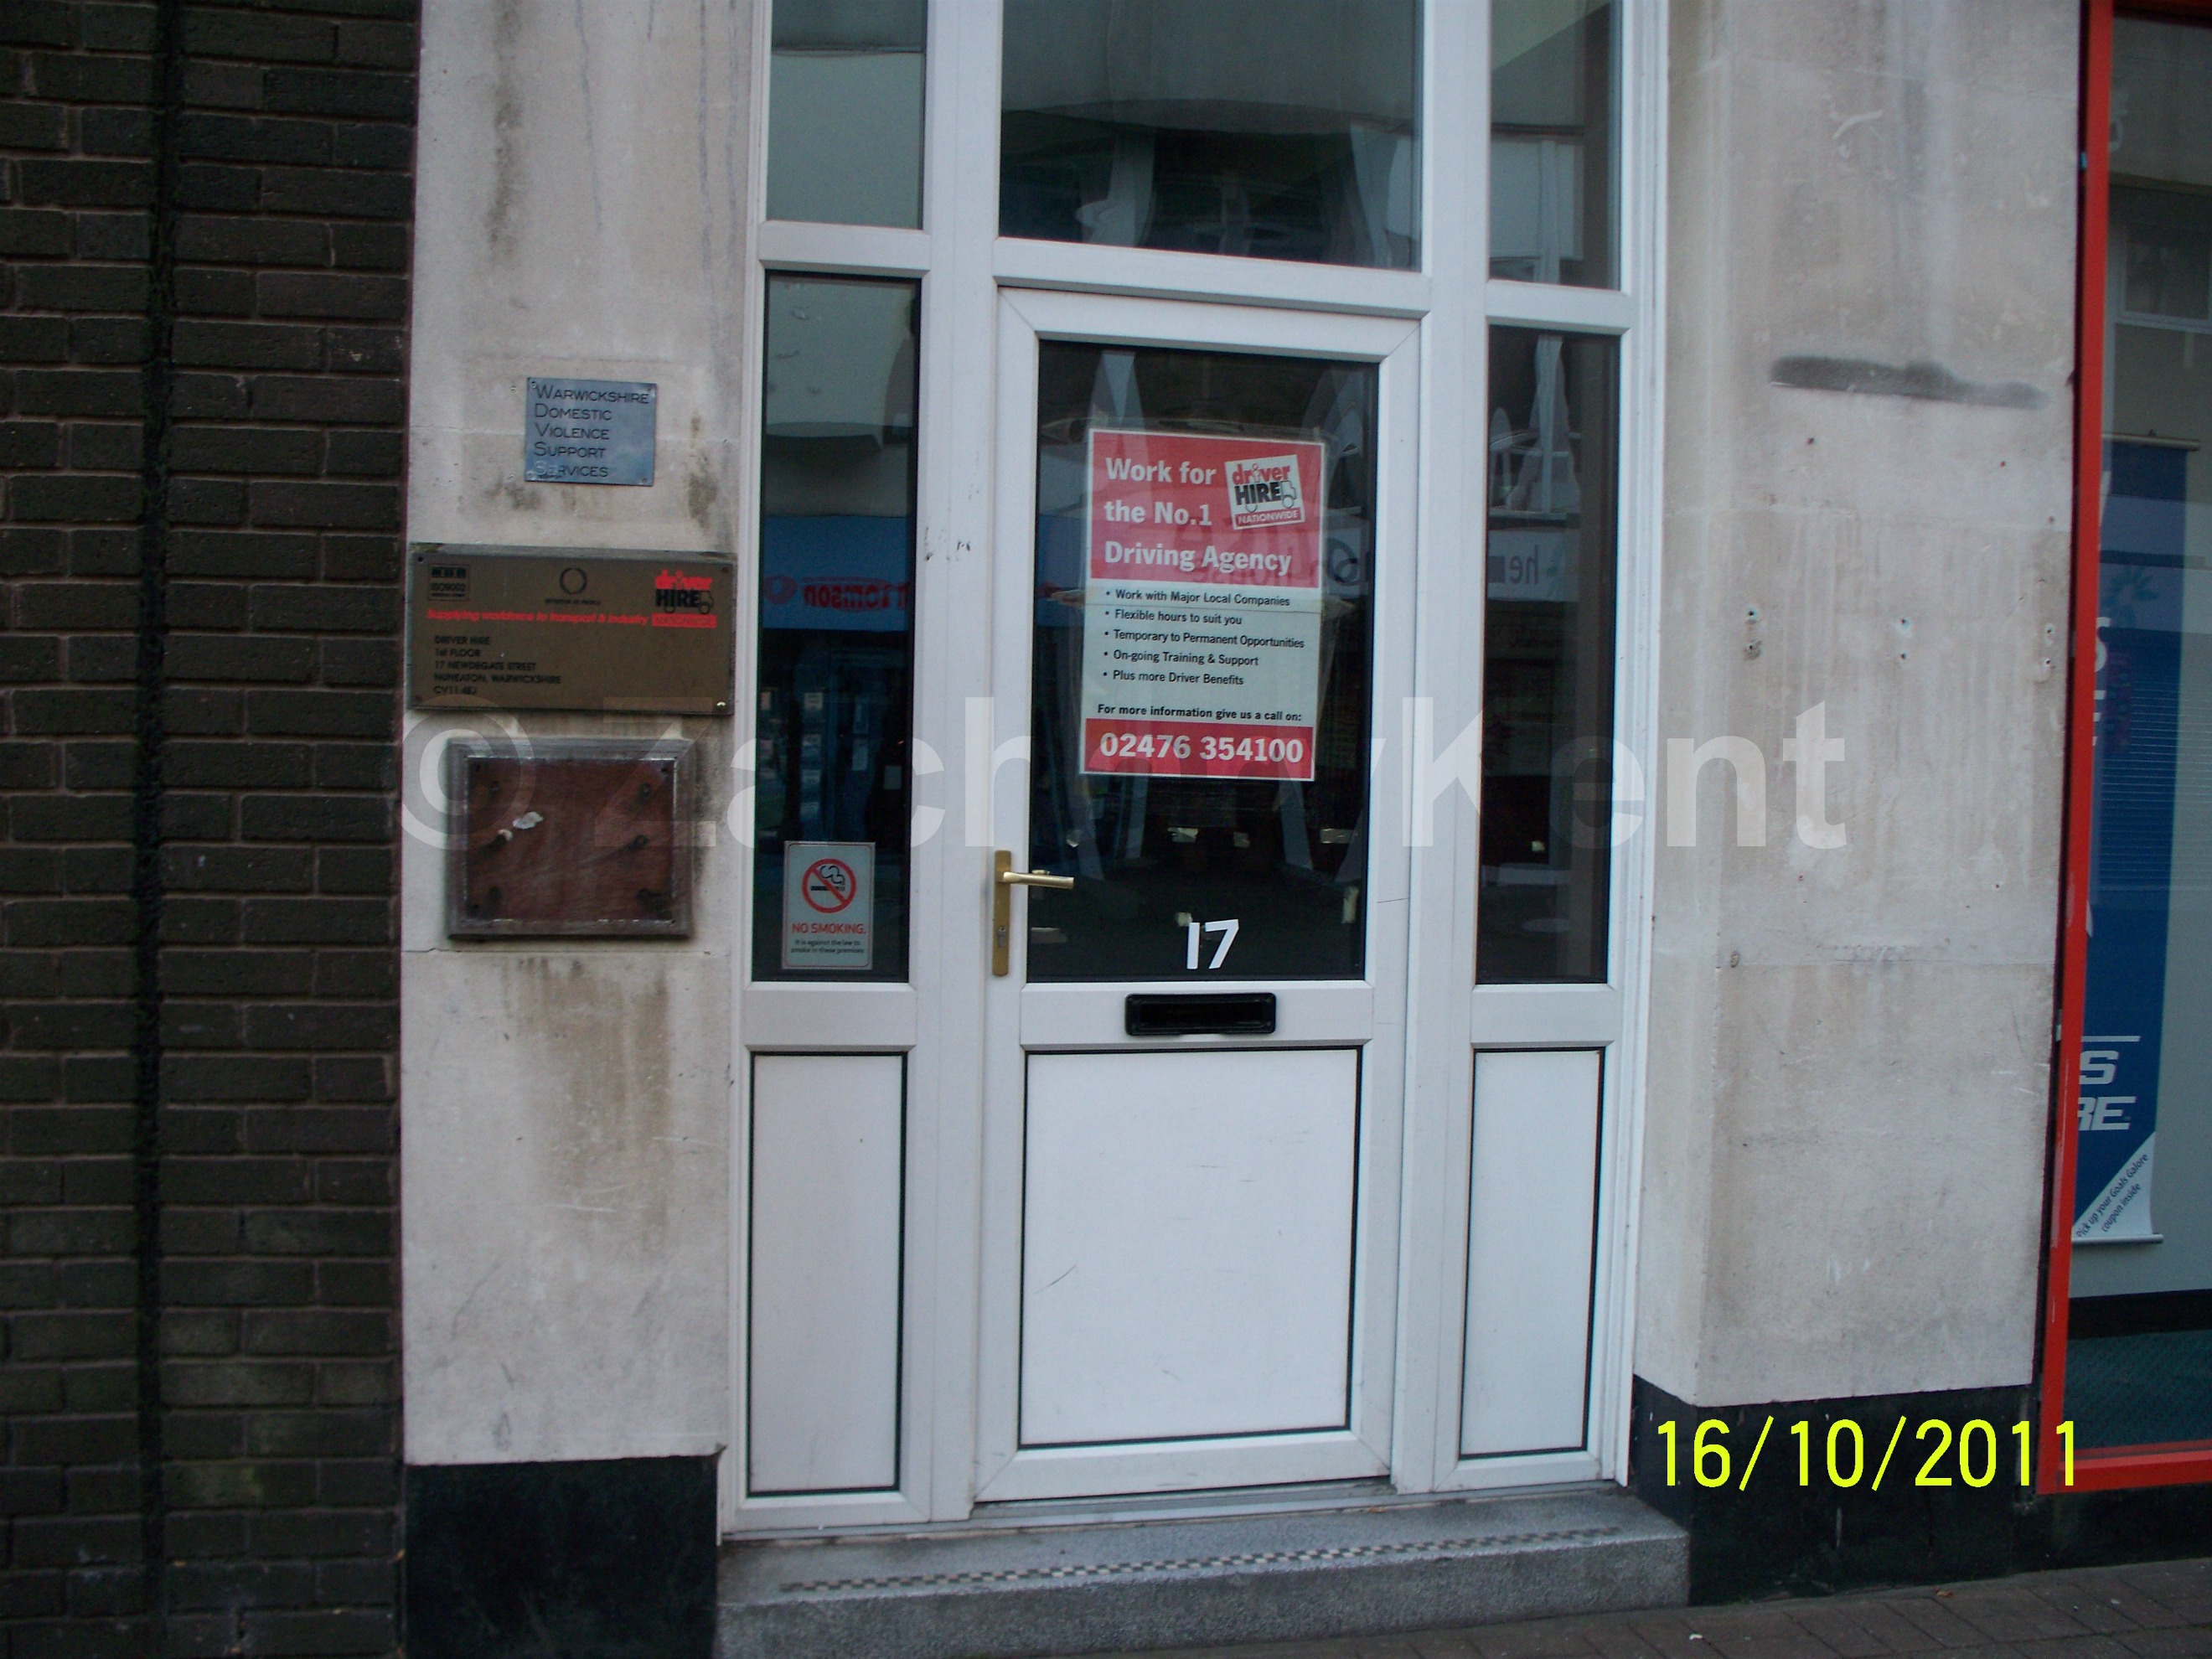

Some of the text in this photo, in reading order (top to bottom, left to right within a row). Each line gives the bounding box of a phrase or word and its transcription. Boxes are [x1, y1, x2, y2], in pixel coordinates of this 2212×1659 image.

[535, 385, 650, 404] WARWICKSHIRE
[534, 403, 612, 421] DOMESTIC
[535, 422, 611, 440] VIOLENCE
[533, 442, 607, 458] SUPPORT
[1105, 457, 1217, 485] Work for
[1232, 463, 1290, 485] driver
[1234, 482, 1282, 505] HIRE
[1104, 499, 1213, 526] the No.1
[1238, 509, 1298, 525] NATIONWIDE
[1104, 540, 1196, 572] Driving
[1201, 545, 1292, 576] Agency
[656, 589, 700, 607] HIRE
[1115, 589, 1291, 607] Work with Major Local Companies
[1114, 609, 1243, 626] Flexible hours to suit you
[1114, 629, 1305, 649] Temporary to Permanent Opportunities
[449, 649, 481, 657] FLOOR
[1114, 649, 1258, 666] On-going Training & Support
[435, 661, 446, 669] 17
[507, 661, 536, 670] STREET
[1114, 670, 1244, 685] Plus more Driver Benefits
[1098, 704, 1301, 721] For more information give us a call on:
[1099, 732, 1304, 762] 02476 354100
[791, 923, 809, 933] NO
[1186, 918, 1239, 969] 17
[2076, 1154, 2147, 1238] Pick up your Goals Galore
[2101, 1183, 2141, 1233] coupon inside
